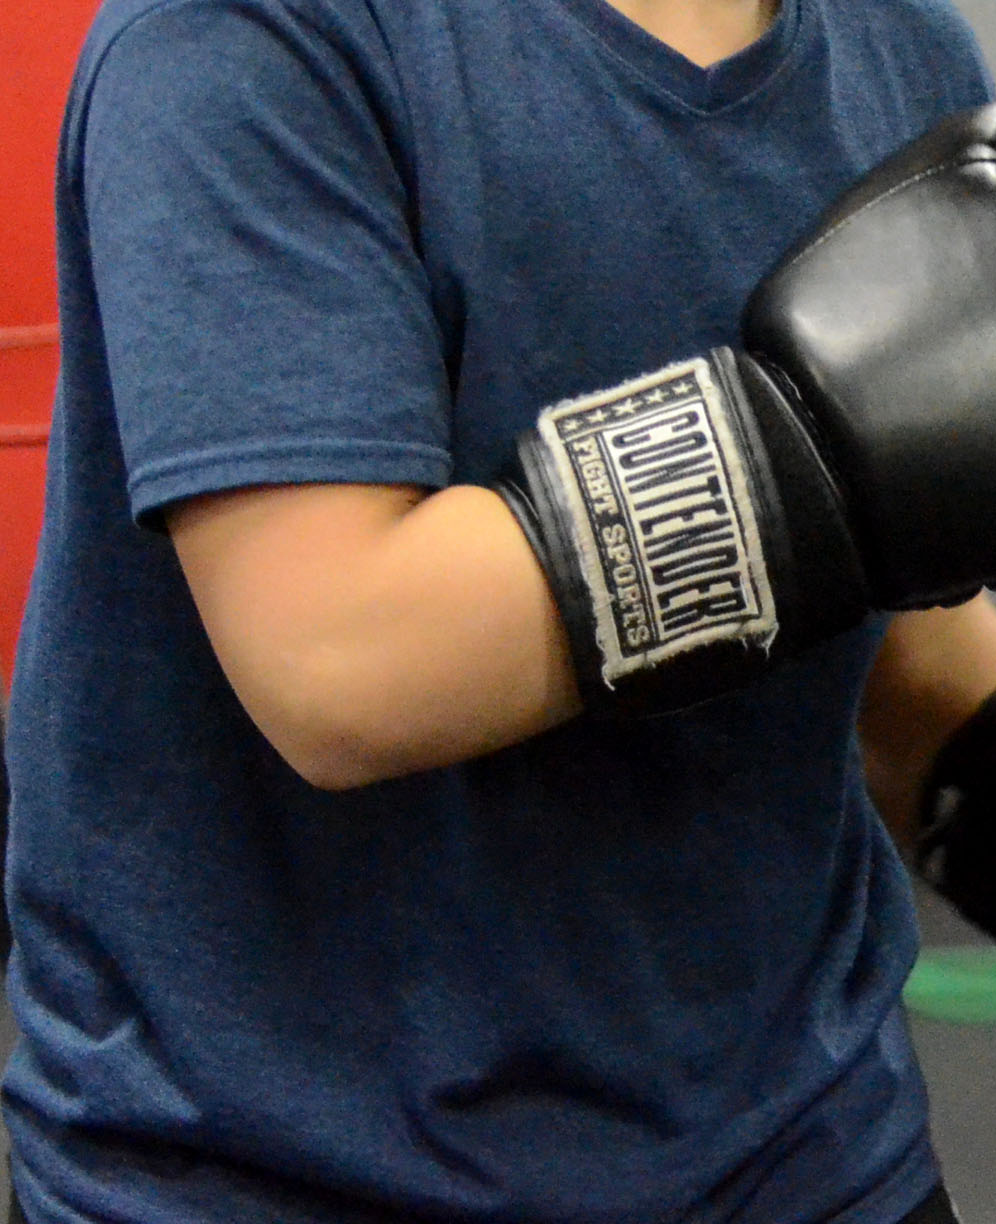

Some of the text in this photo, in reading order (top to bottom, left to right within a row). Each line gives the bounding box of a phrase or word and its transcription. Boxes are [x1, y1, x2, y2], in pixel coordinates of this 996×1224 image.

[573, 436, 650, 647] FIGHT SPORTS
[611, 410, 748, 631] CONTENDER
